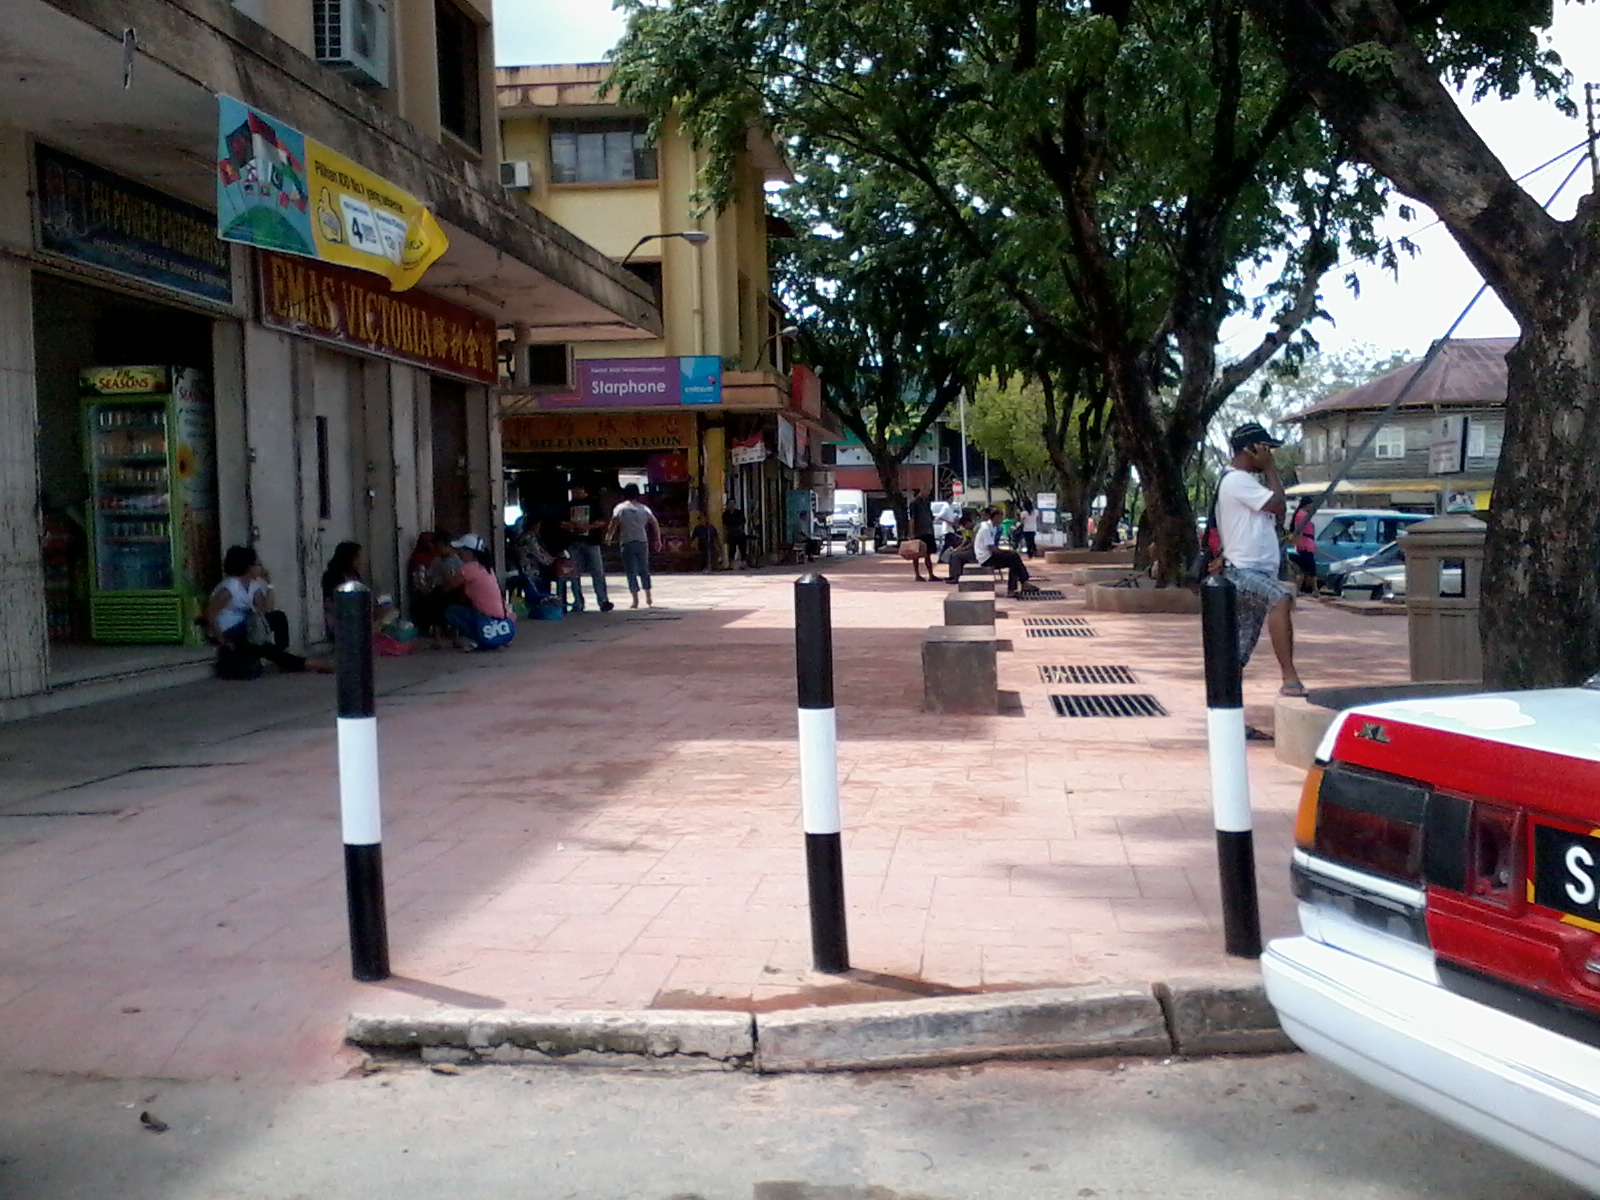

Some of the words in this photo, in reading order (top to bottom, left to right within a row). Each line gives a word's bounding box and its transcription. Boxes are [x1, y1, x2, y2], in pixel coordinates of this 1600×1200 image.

[352, 217, 363, 244] 4
[271, 256, 338, 331] EMAS
[342, 281, 433, 358] VICTORIA
[100, 378, 149, 390] SEASONS
[591, 379, 667, 397] Starphone
[530, 437, 608, 449] BILLIARD
[620, 437, 682, 446] SALOON
[1356, 722, 1391, 743] XL
[1564, 845, 1600, 911] S
